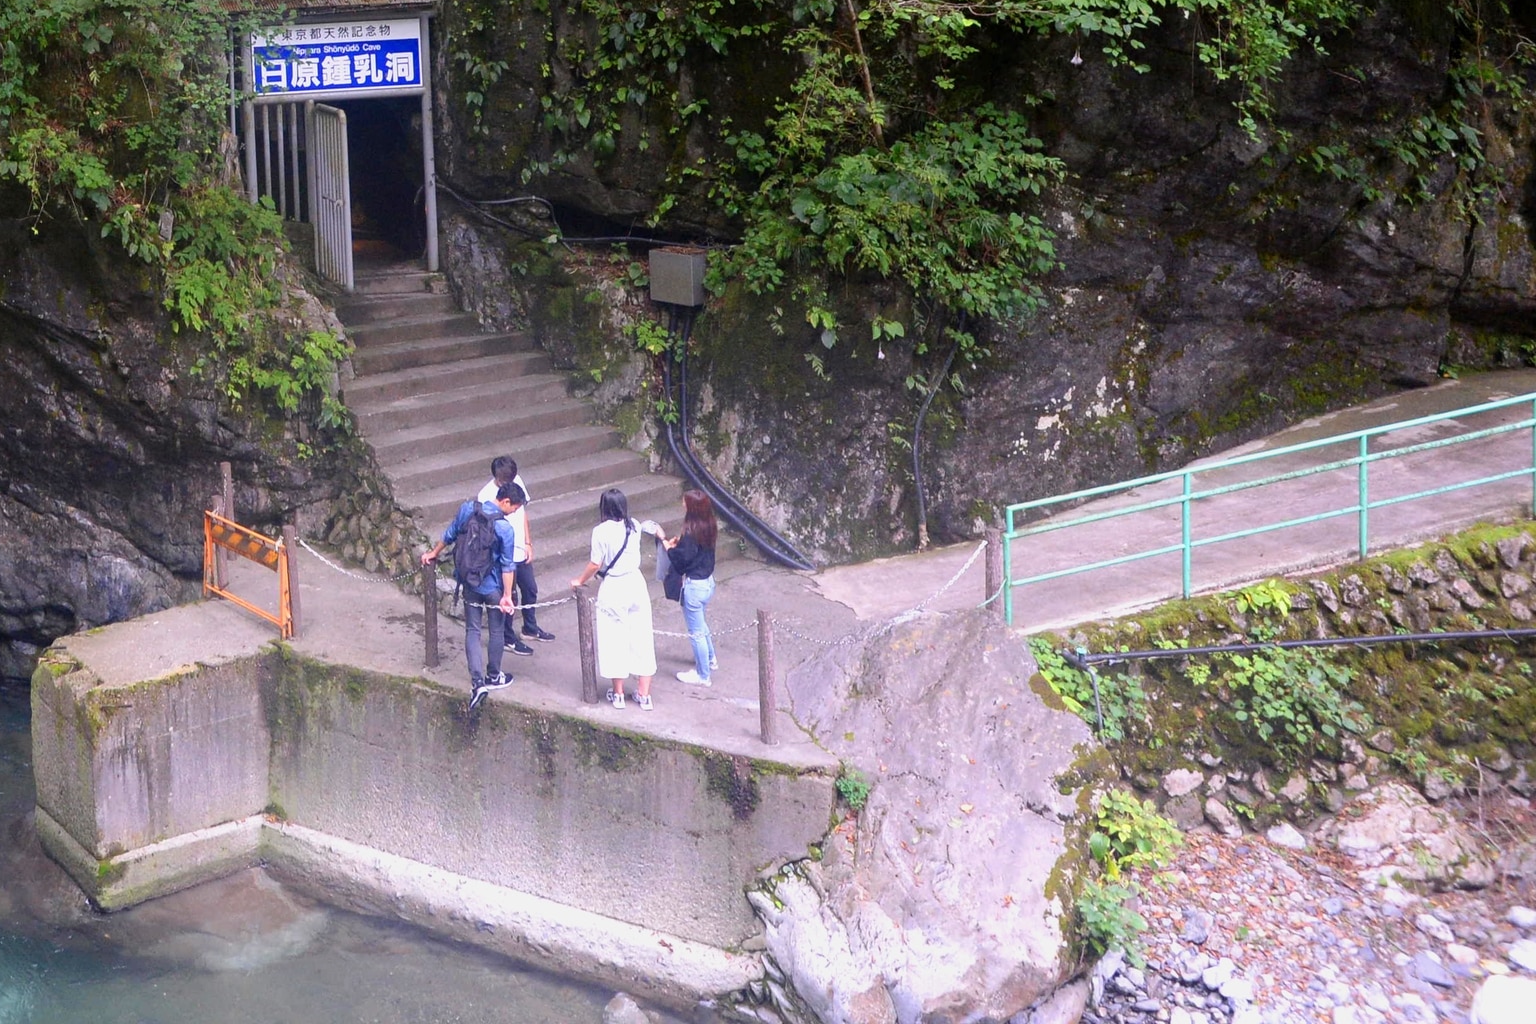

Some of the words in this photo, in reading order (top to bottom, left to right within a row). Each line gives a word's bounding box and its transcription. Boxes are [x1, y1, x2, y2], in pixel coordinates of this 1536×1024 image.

[282, 25, 391, 41] 東京都天然記念物
[292, 47, 321, 56] Nipara
[362, 43, 381, 51] Cave
[261, 52, 414, 87] 日原鍾乳洞
